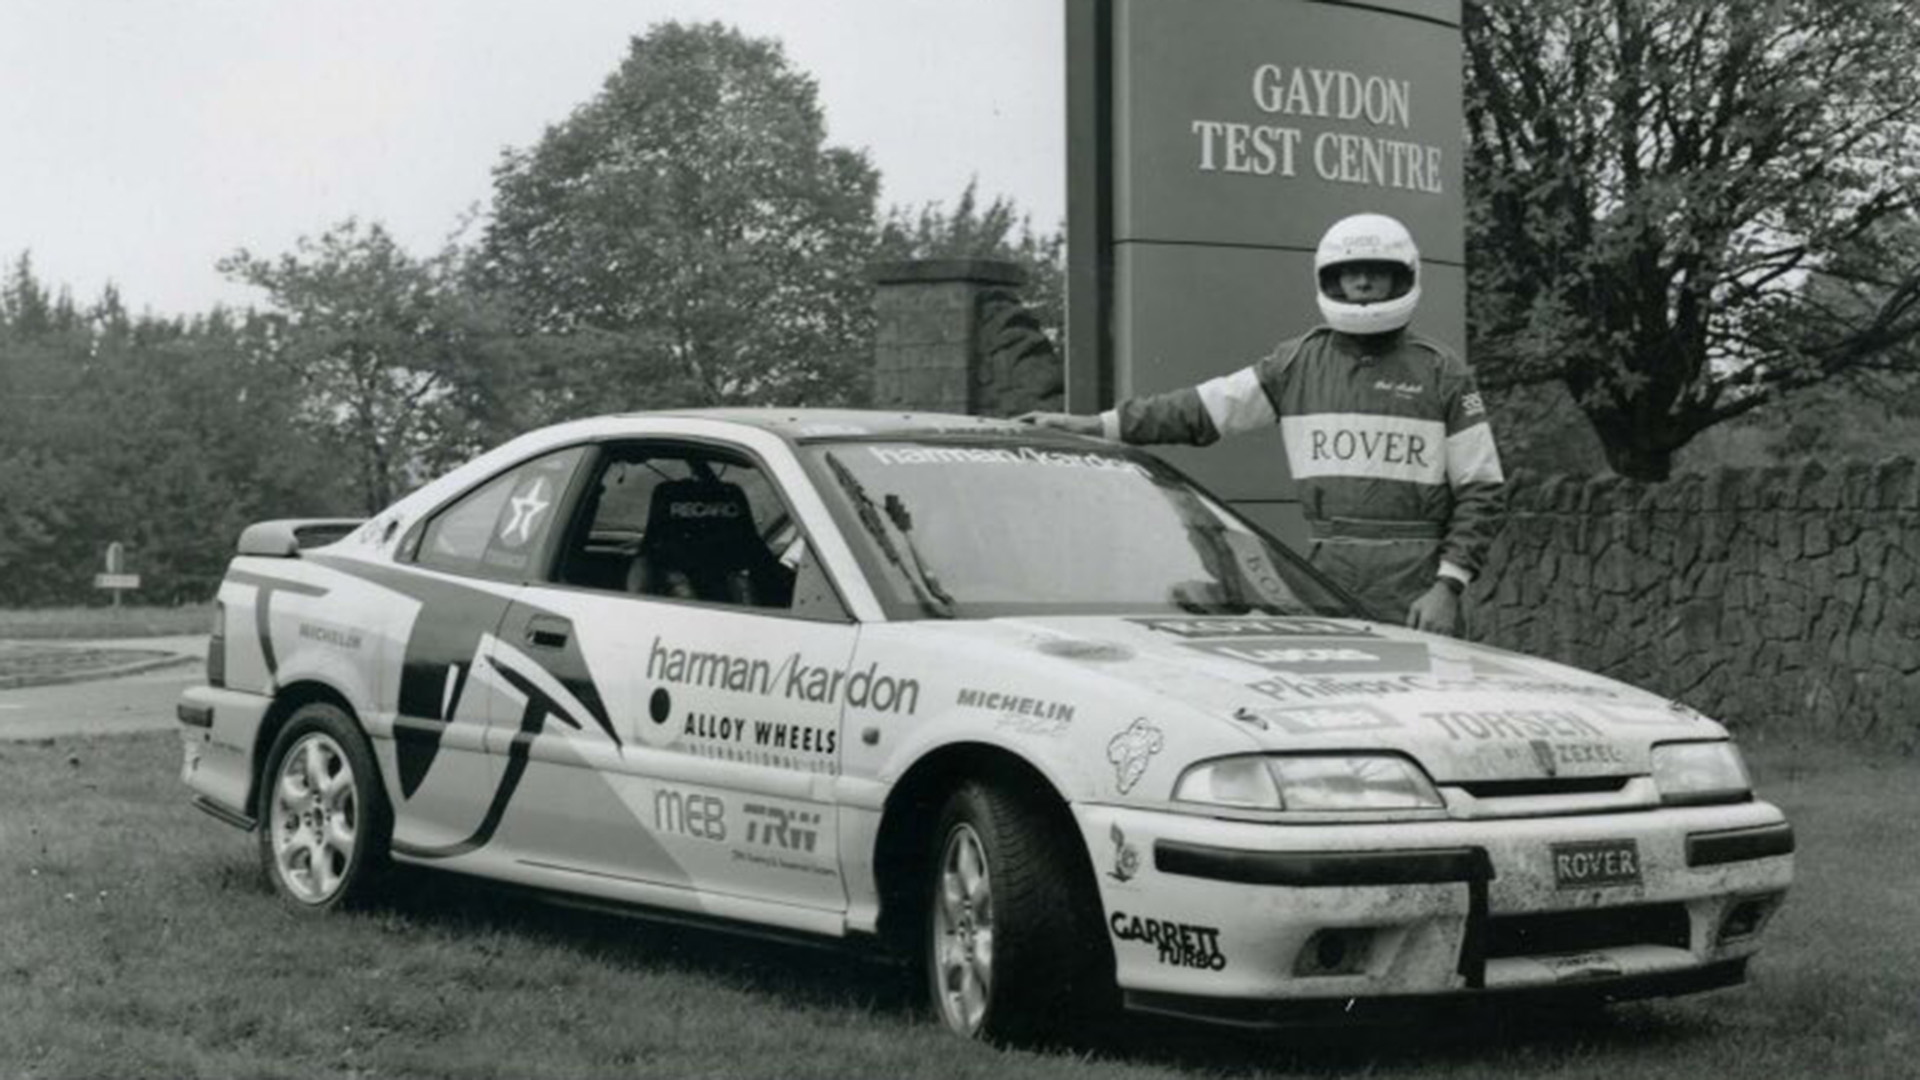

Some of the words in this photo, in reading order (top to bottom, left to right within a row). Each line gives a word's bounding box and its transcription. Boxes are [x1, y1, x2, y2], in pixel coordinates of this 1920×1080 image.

[1252, 64, 1411, 129] GAYDON
[1192, 120, 1301, 177] TEST
[1314, 131, 1443, 194] CENTRE
[868, 444, 1155, 479] harman/kardon
[1310, 428, 1429, 468] ROVER
[647, 635, 920, 715] harman/kardon
[956, 688, 1076, 723] MICHELIN
[1421, 709, 1604, 741] TORSEN
[684, 711, 746, 741] ALLOY
[754, 721, 837, 754] WHEELS
[1556, 743, 1622, 764] ZEXEL
[654, 788, 727, 842] MEB
[743, 804, 821, 853] TRW
[1556, 850, 1637, 879] ROVER
[1110, 911, 1220, 953] GARRETT
[1158, 944, 1227, 972] TURBO
